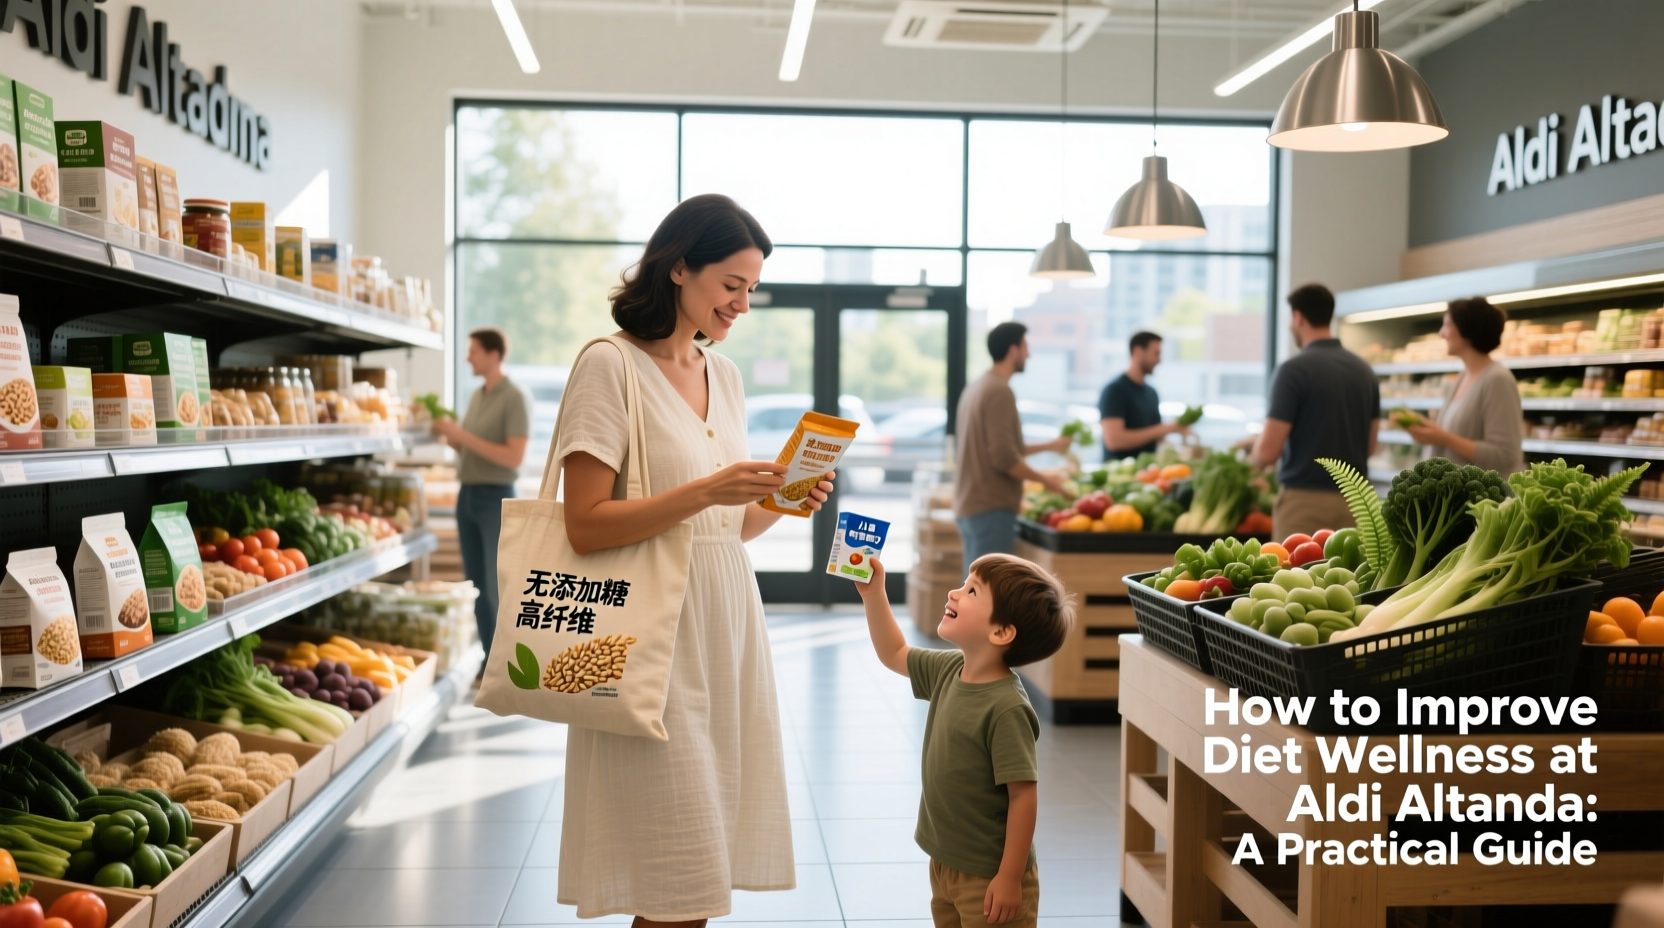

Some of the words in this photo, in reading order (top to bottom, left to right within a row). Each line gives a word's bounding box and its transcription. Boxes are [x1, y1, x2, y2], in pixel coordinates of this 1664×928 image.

[1487, 112, 1559, 196] Aldi
[523, 569, 631, 607] 无添加糖
[516, 599, 596, 634] 高纤维
